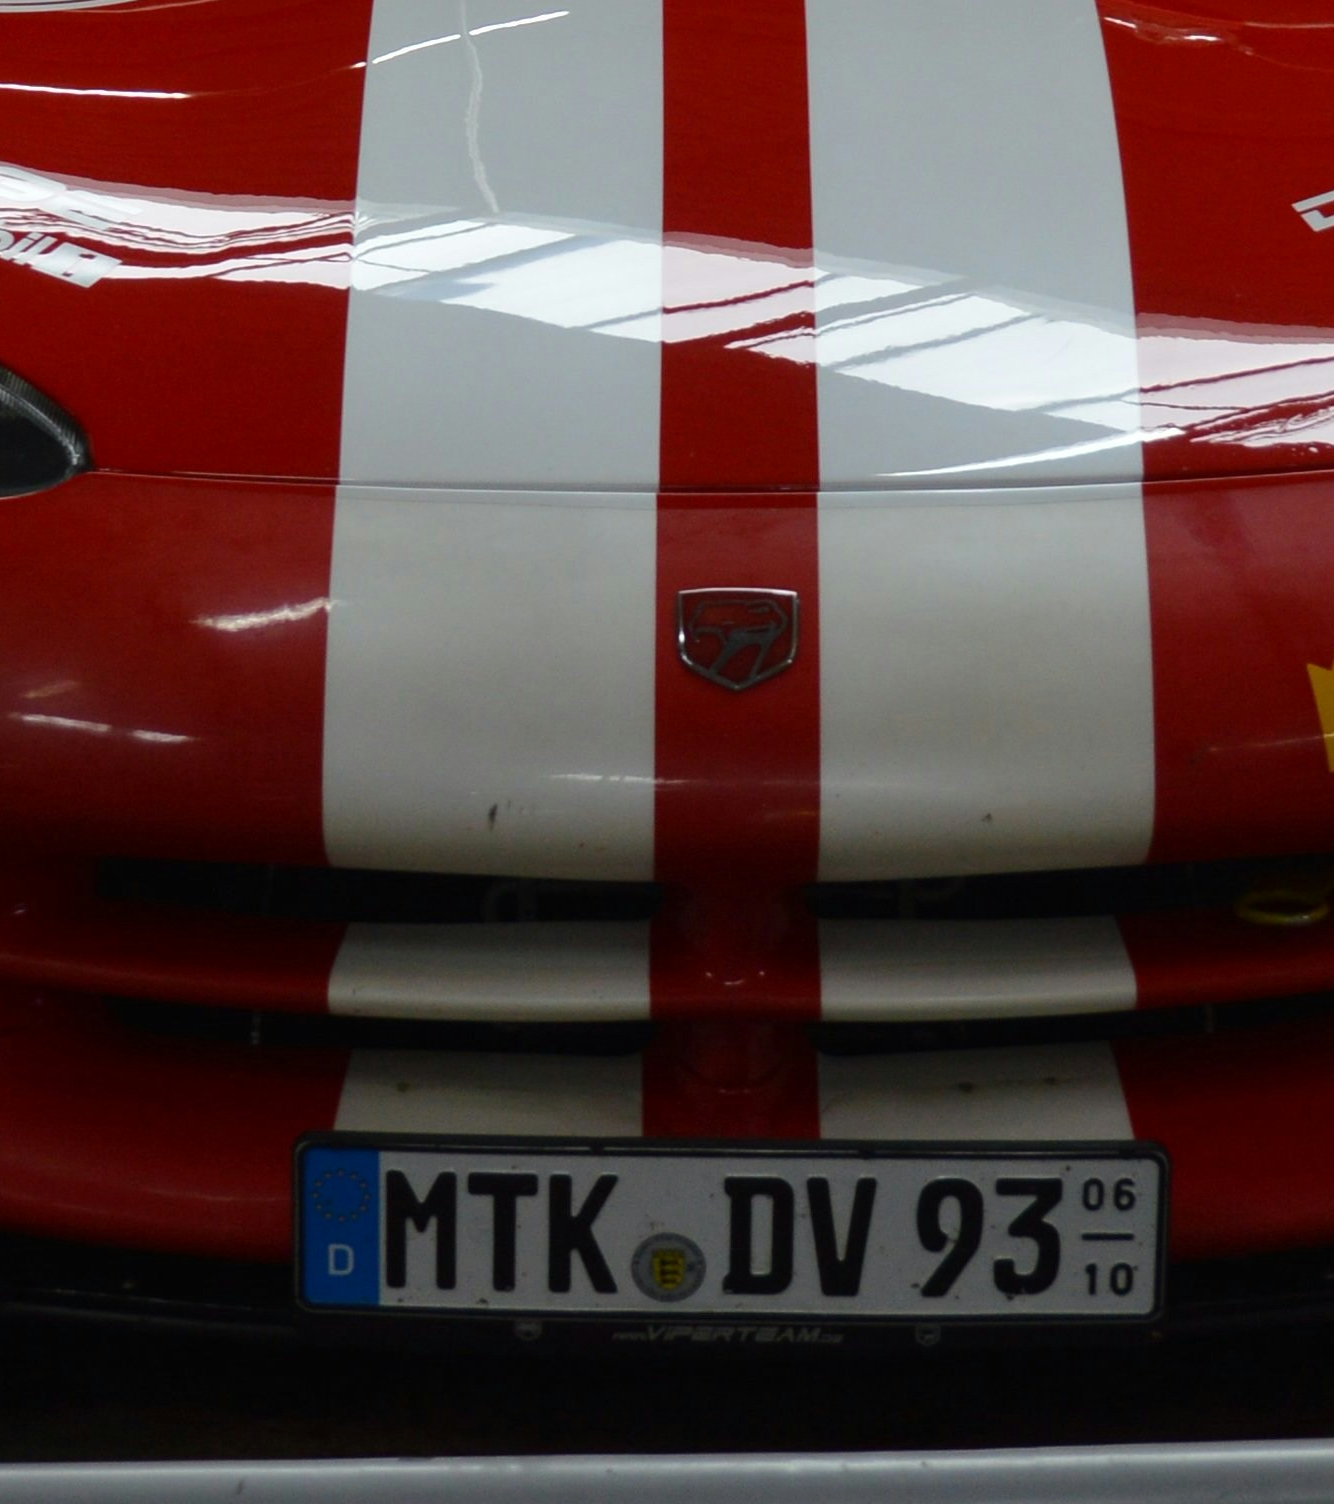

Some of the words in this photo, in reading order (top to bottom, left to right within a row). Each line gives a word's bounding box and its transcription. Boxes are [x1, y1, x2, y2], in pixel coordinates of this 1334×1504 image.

[1081, 1177, 1137, 1212] 06
[385, 1169, 619, 1294] MTK
[722, 1176, 878, 1297] DV
[915, 1176, 1064, 1297] 93
[327, 1243, 355, 1276] D
[1084, 1262, 1135, 1296] 10
